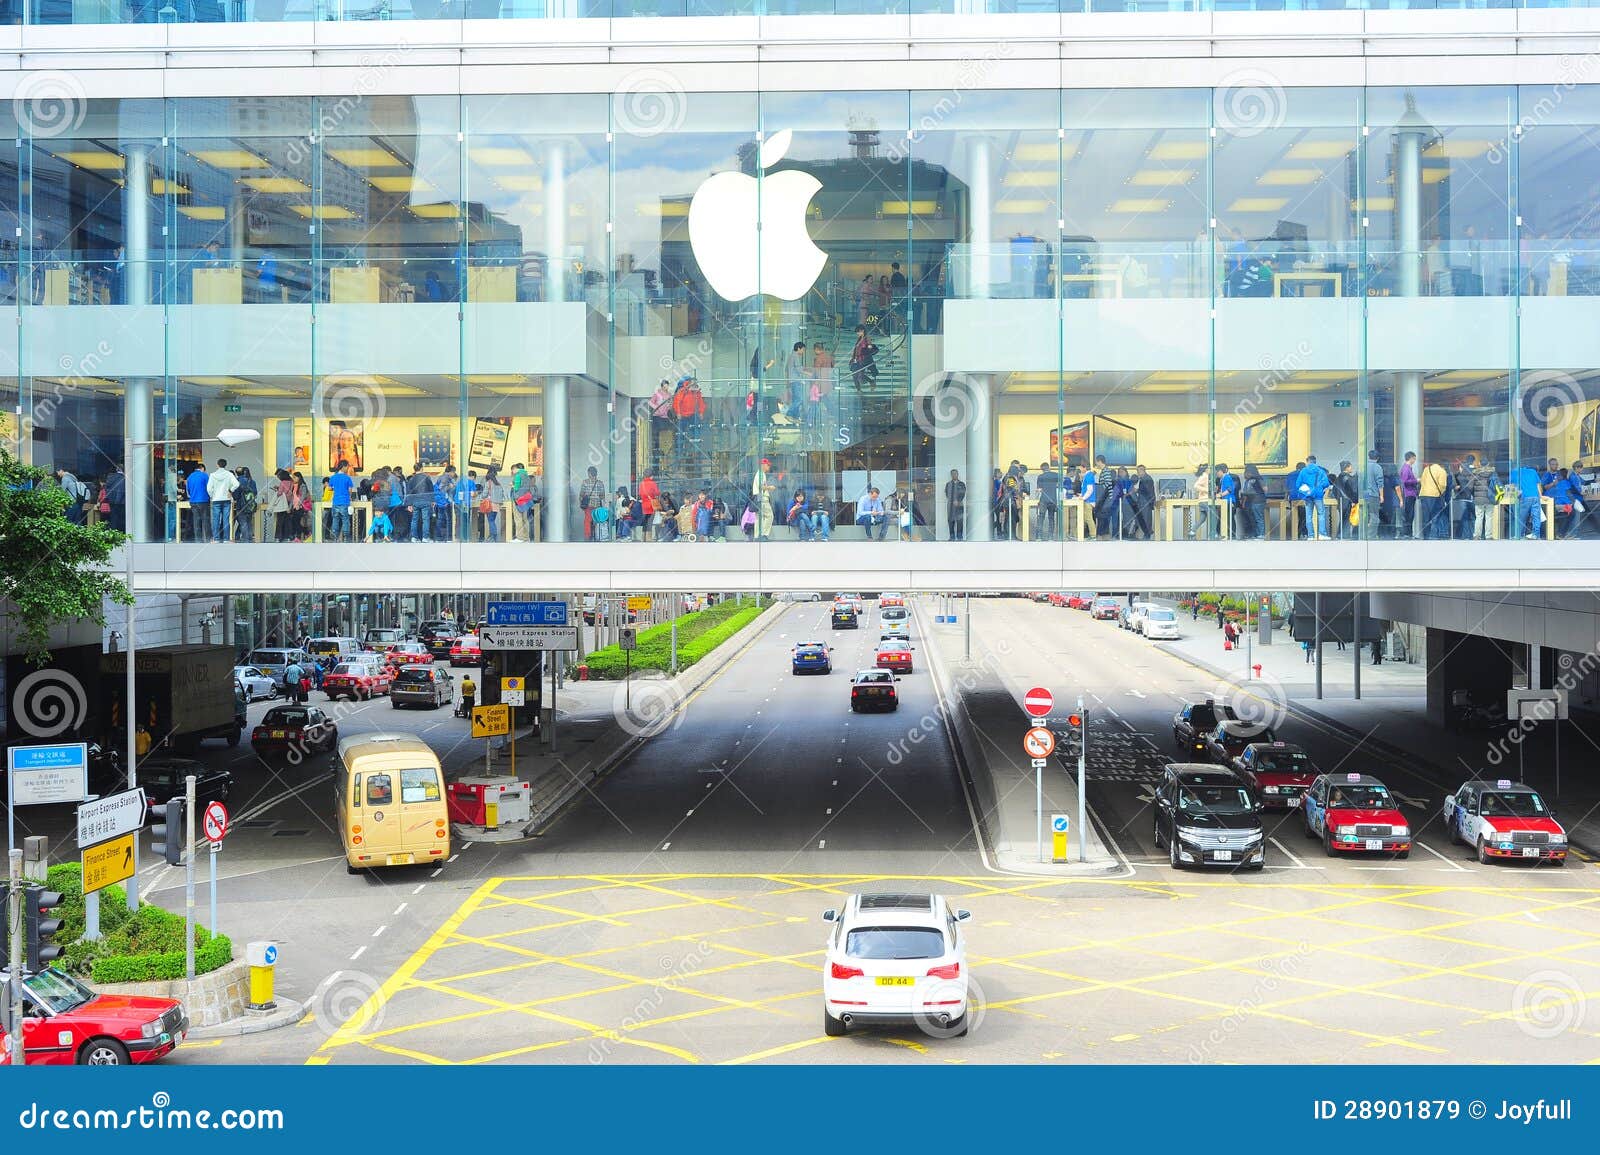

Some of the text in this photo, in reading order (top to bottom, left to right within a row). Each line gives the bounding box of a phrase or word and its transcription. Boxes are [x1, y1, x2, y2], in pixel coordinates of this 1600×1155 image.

[527, 603, 540, 611] (W)
[80, 796, 138, 819] Airport Express Station
[86, 847, 121, 866] Finance Street
